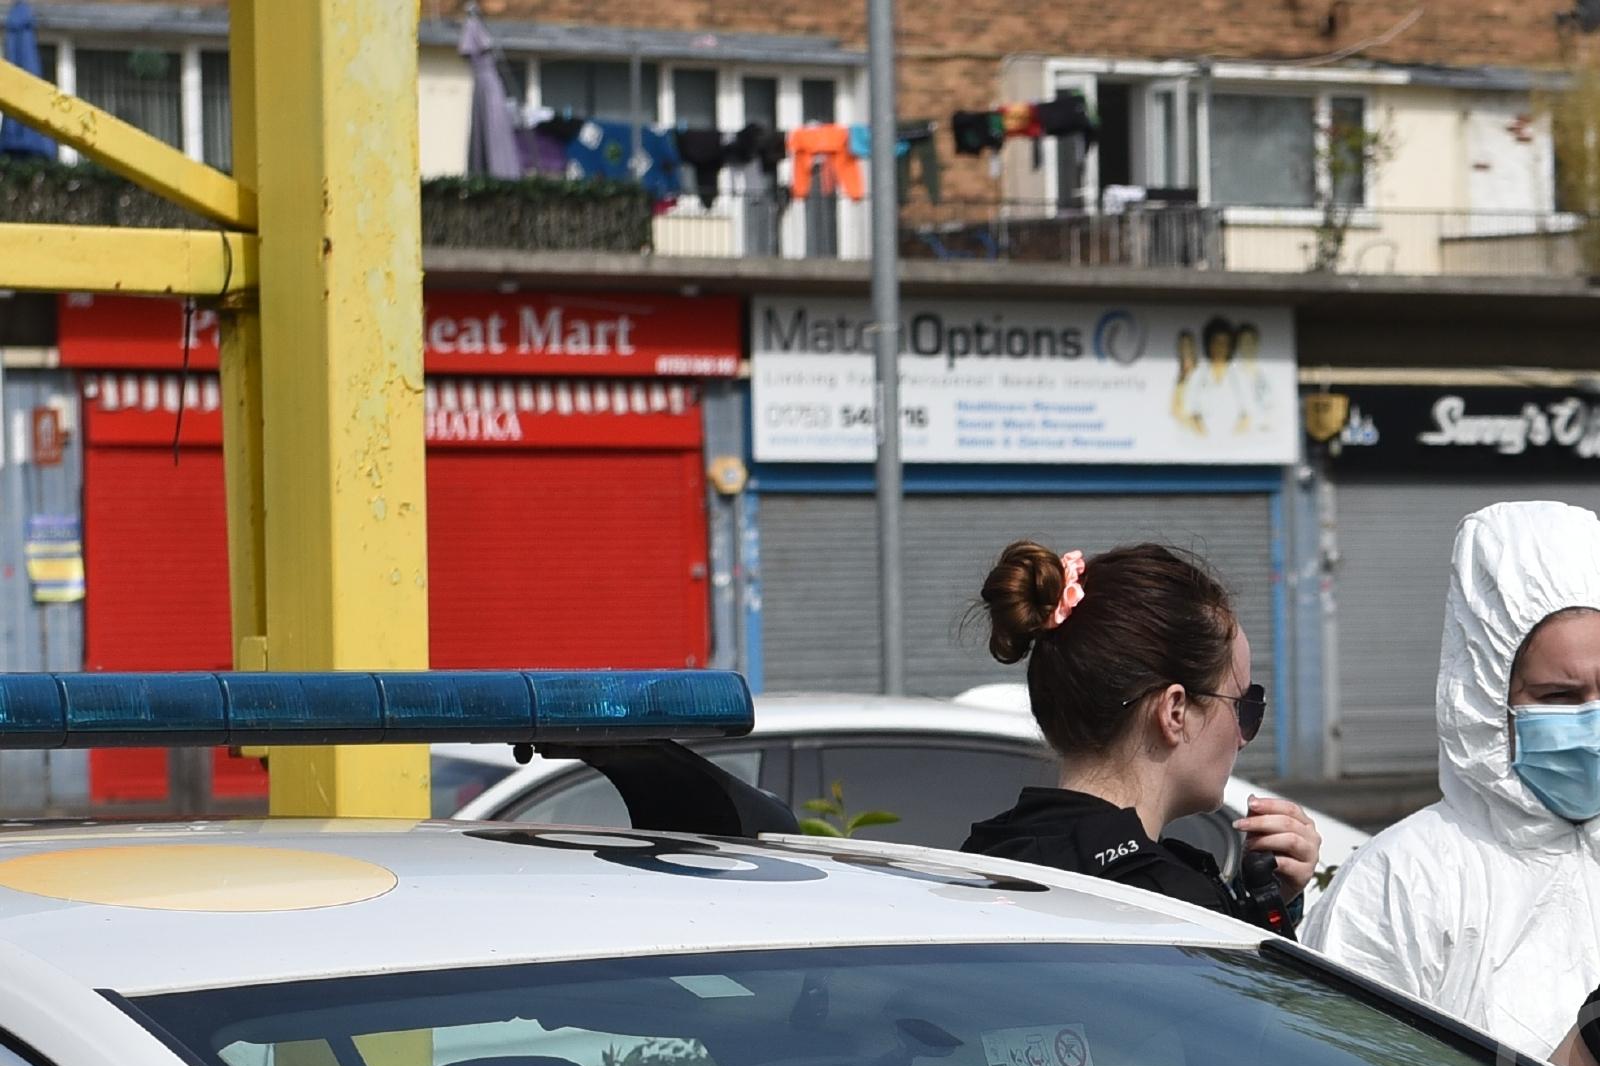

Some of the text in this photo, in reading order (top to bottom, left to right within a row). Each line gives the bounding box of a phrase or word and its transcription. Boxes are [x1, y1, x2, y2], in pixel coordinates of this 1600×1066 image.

[424, 312, 506, 354] eat
[517, 306, 636, 356] Mart
[762, 309, 1083, 371] MatcOptions
[1095, 838, 1140, 867] 7263
